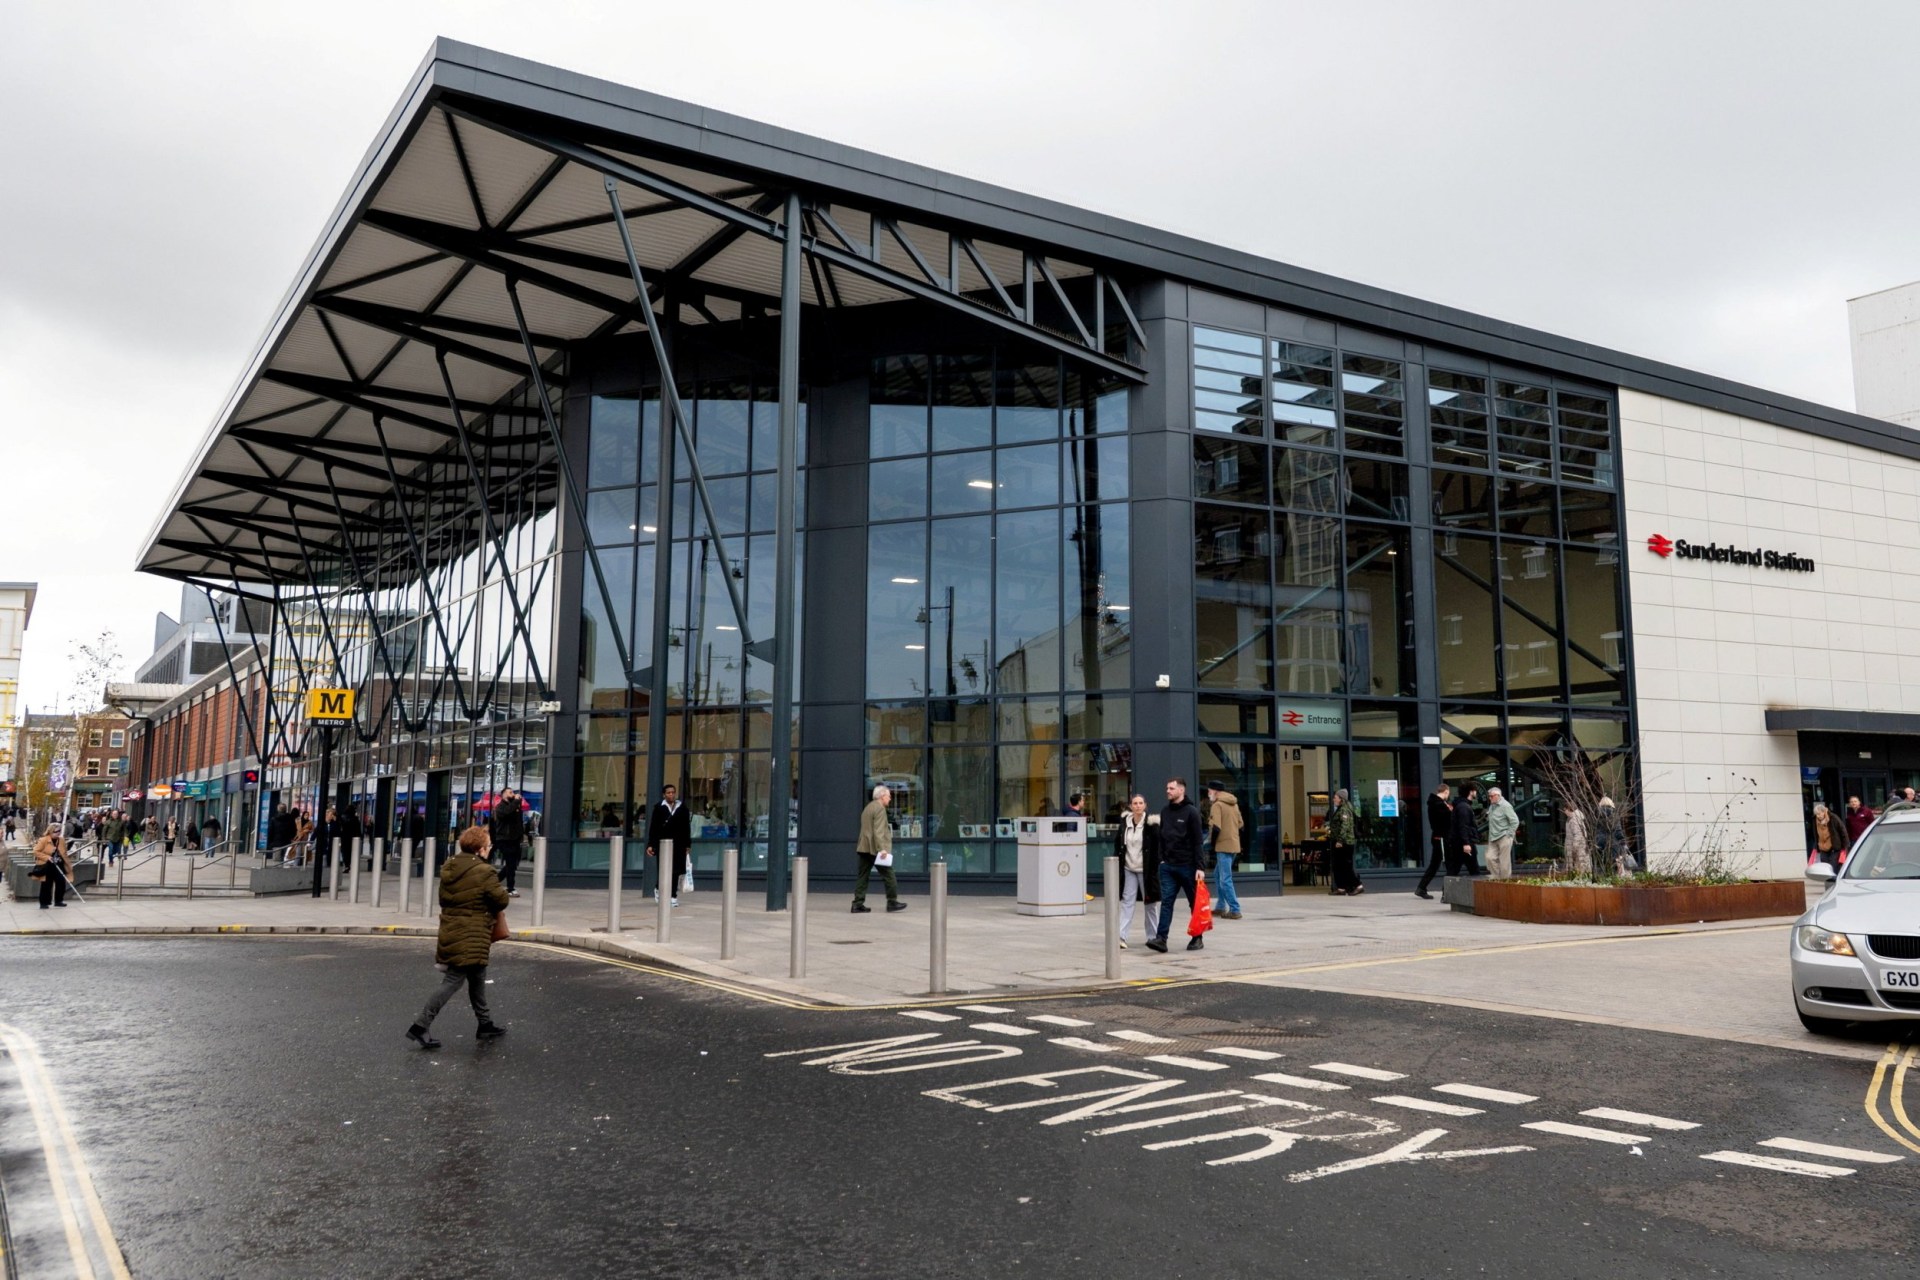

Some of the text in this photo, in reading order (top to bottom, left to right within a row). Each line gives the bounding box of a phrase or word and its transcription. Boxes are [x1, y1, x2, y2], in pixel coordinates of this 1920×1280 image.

[1675, 539, 1815, 573] Sunderland Station
[319, 692, 346, 714] M
[1308, 715, 1341, 725] Entrance
[763, 1032, 1023, 1075] NO
[920, 1065, 1537, 1184] ENTRY
